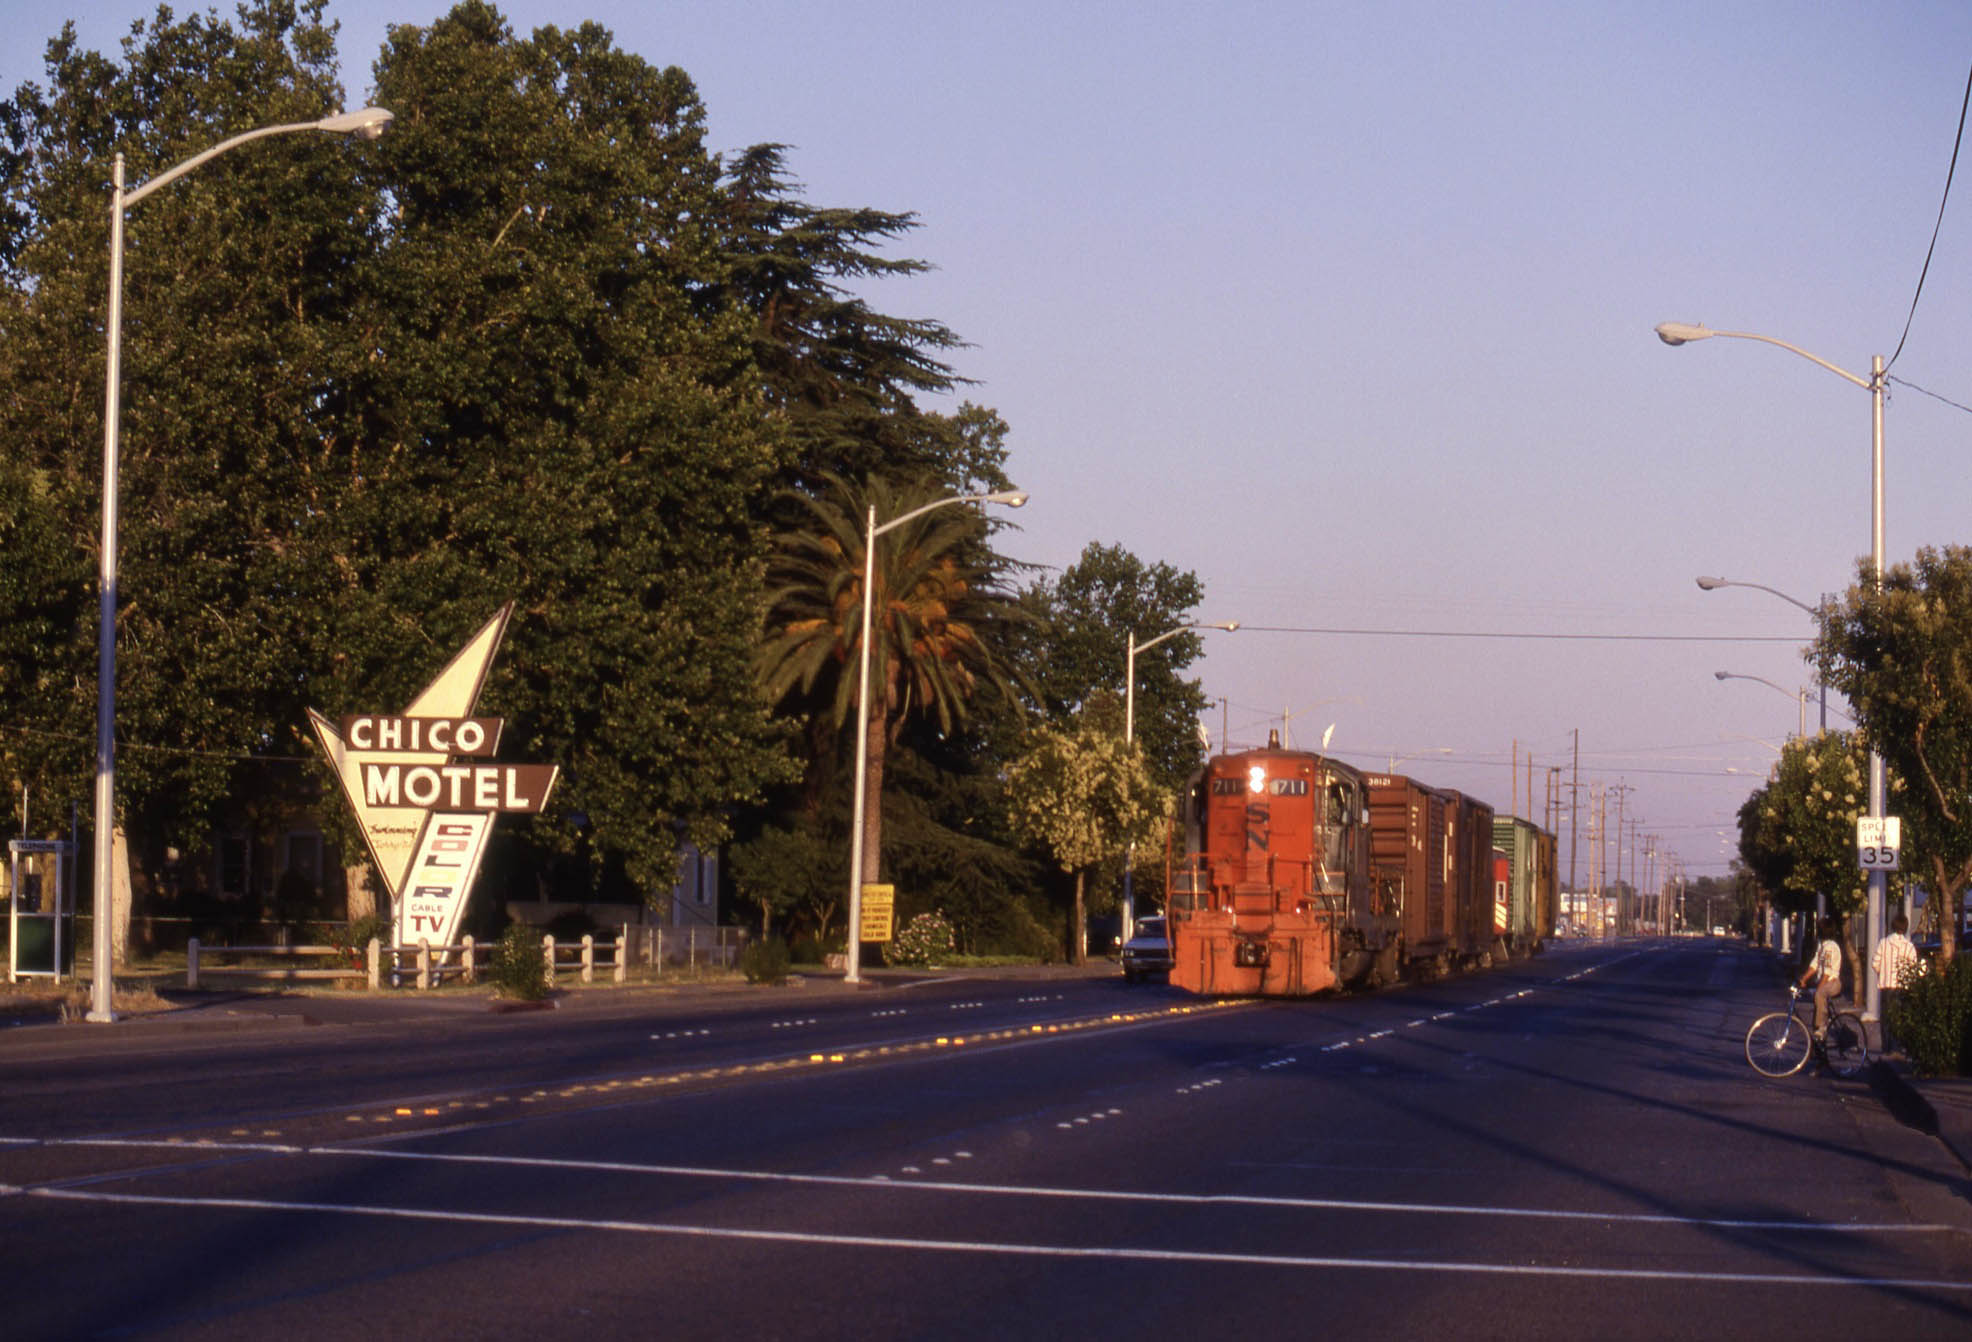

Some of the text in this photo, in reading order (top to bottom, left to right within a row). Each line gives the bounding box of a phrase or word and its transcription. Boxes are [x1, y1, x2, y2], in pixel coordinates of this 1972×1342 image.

[350, 718, 485, 752] CHICO
[366, 765, 529, 809] MOTEL
[1278, 779, 1305, 794] 711
[1863, 835, 1888, 843] LIMI
[1863, 846, 1894, 864] 35
[411, 904, 443, 912] CABLE
[410, 915, 445, 933] TV
